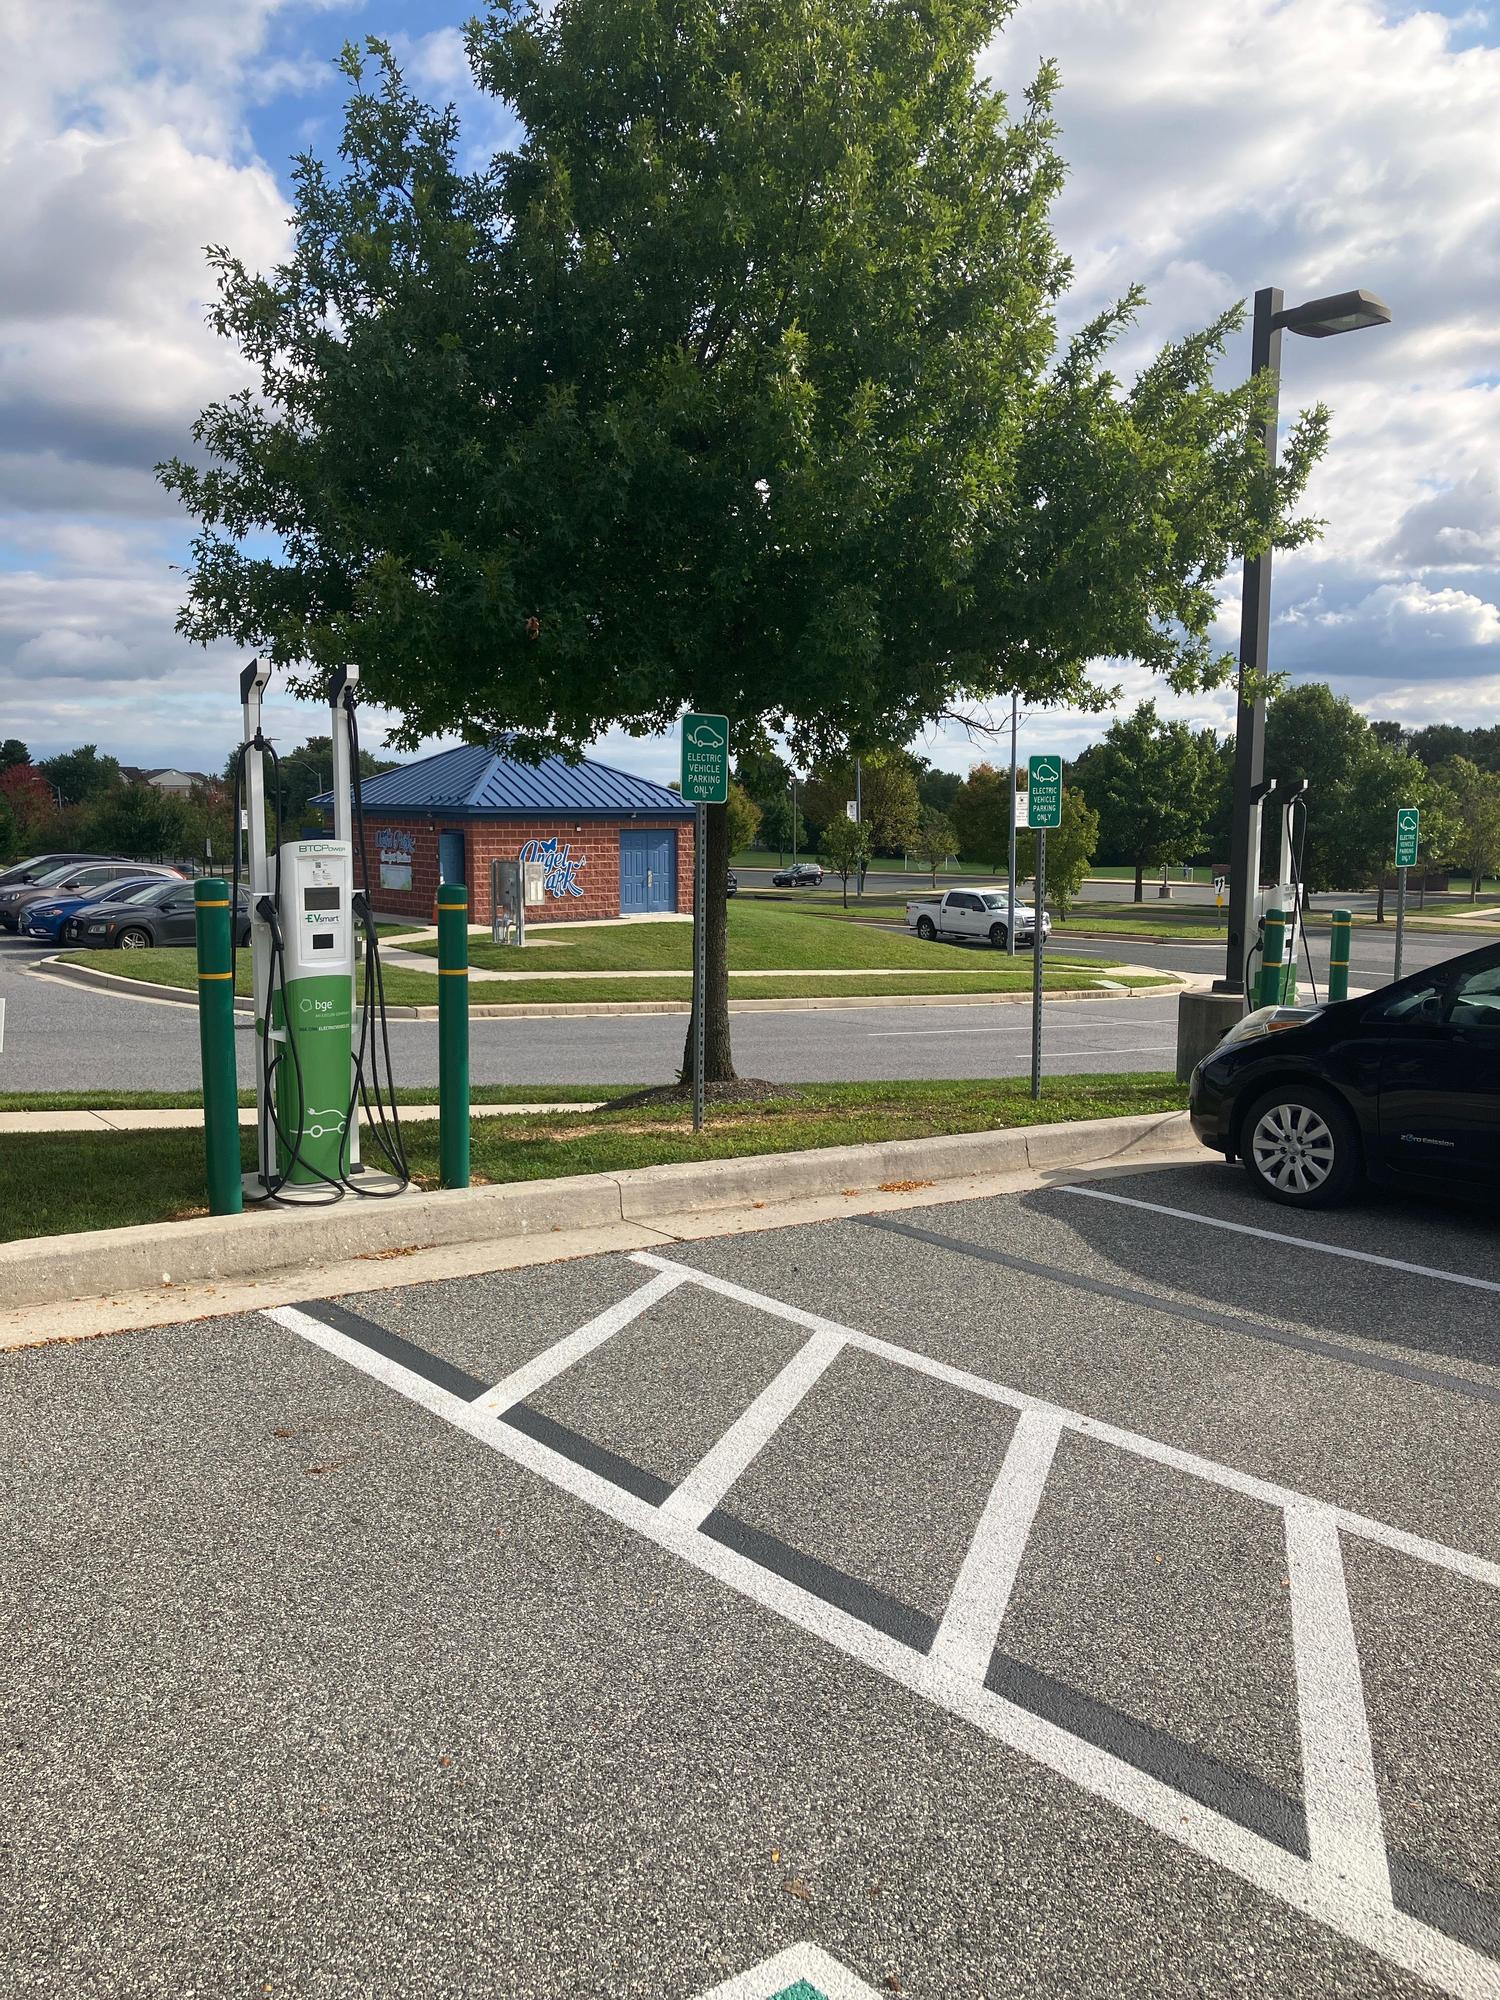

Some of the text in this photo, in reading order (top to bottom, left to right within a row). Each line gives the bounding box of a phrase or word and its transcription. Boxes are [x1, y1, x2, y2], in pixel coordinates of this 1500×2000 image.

[688, 753, 722, 762] ELECTRIC
[689, 764, 720, 773] VEHICLE
[688, 775, 720, 784] PARKING
[694, 786, 714, 794] ONLY
[519, 840, 570, 875] Angel
[544, 861, 584, 898] ark
[315, 999, 333, 1012] bge
